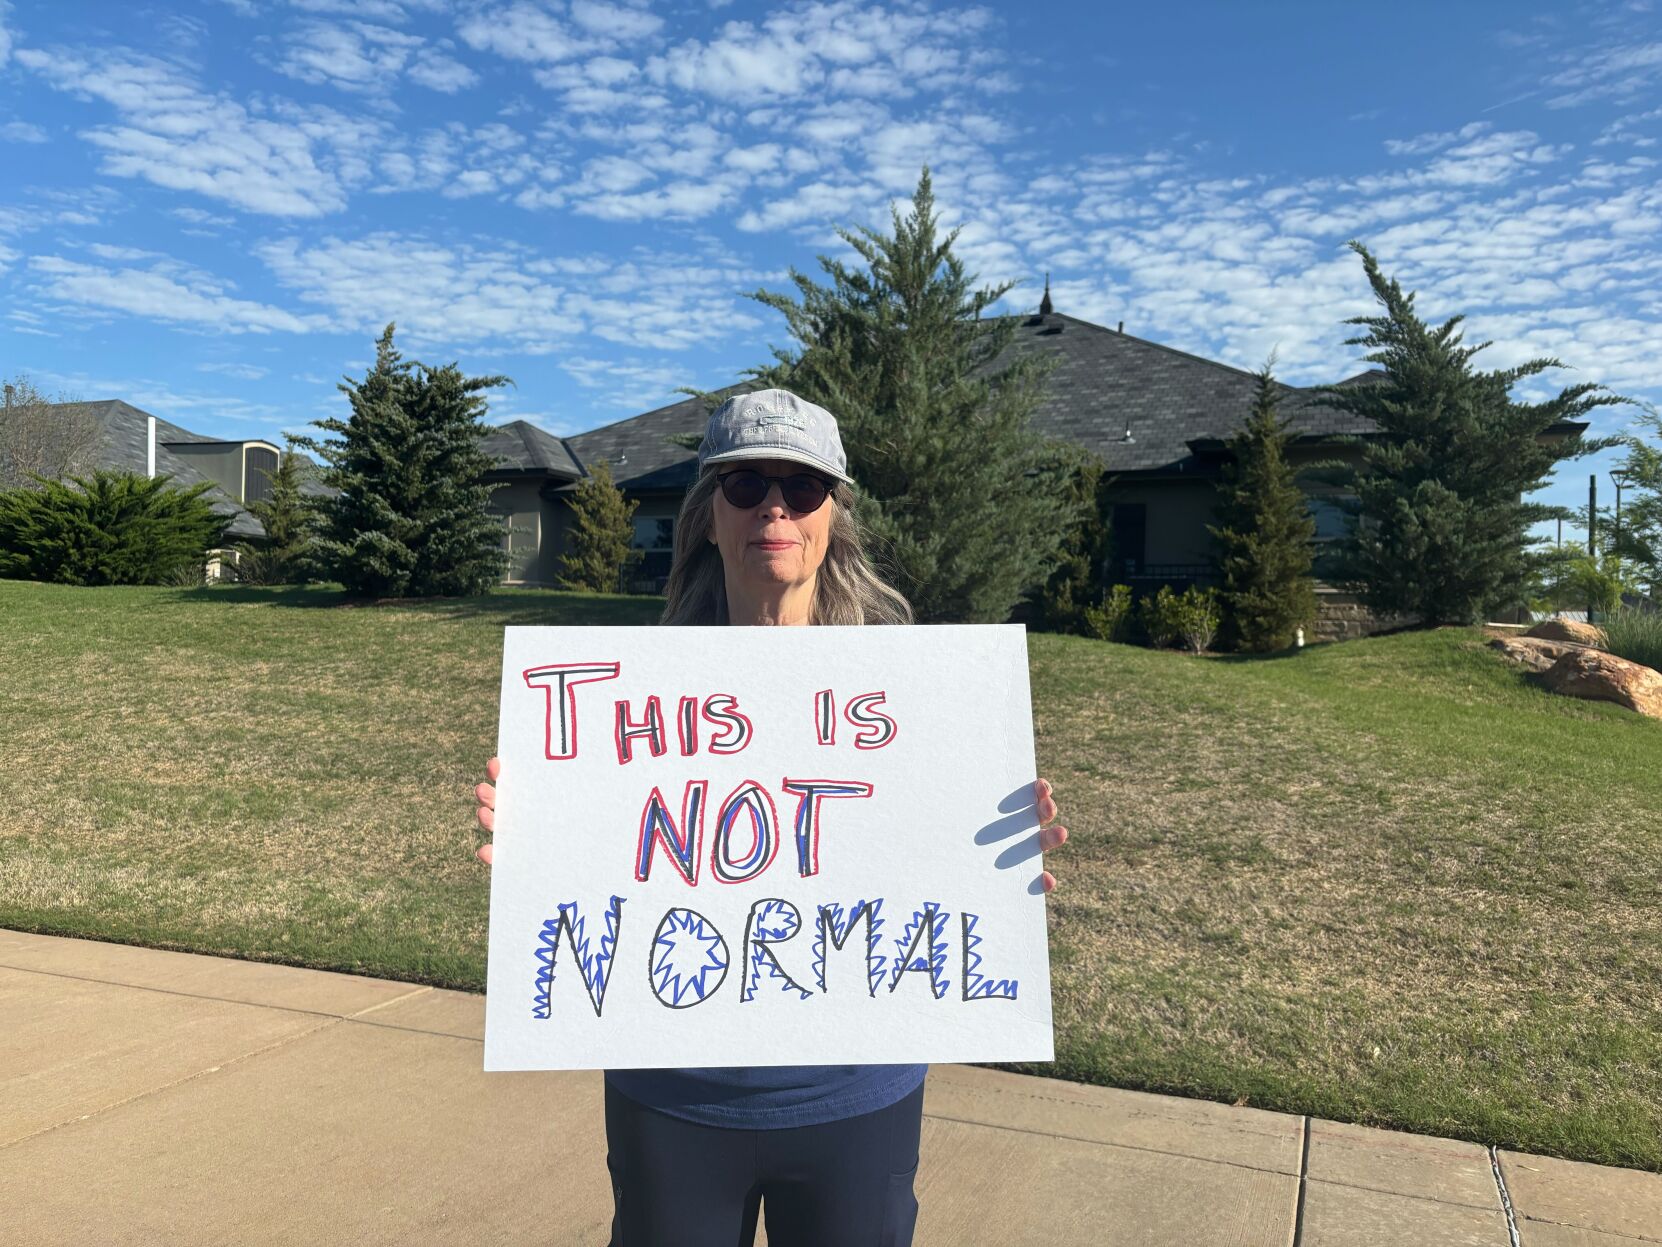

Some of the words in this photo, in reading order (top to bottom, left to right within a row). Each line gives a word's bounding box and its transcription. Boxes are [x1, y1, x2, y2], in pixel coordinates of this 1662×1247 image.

[523, 662, 753, 765] THIS
[815, 689, 897, 750] IS
[635, 777, 873, 887] NOT
[532, 895, 1018, 1019] NORMAL
